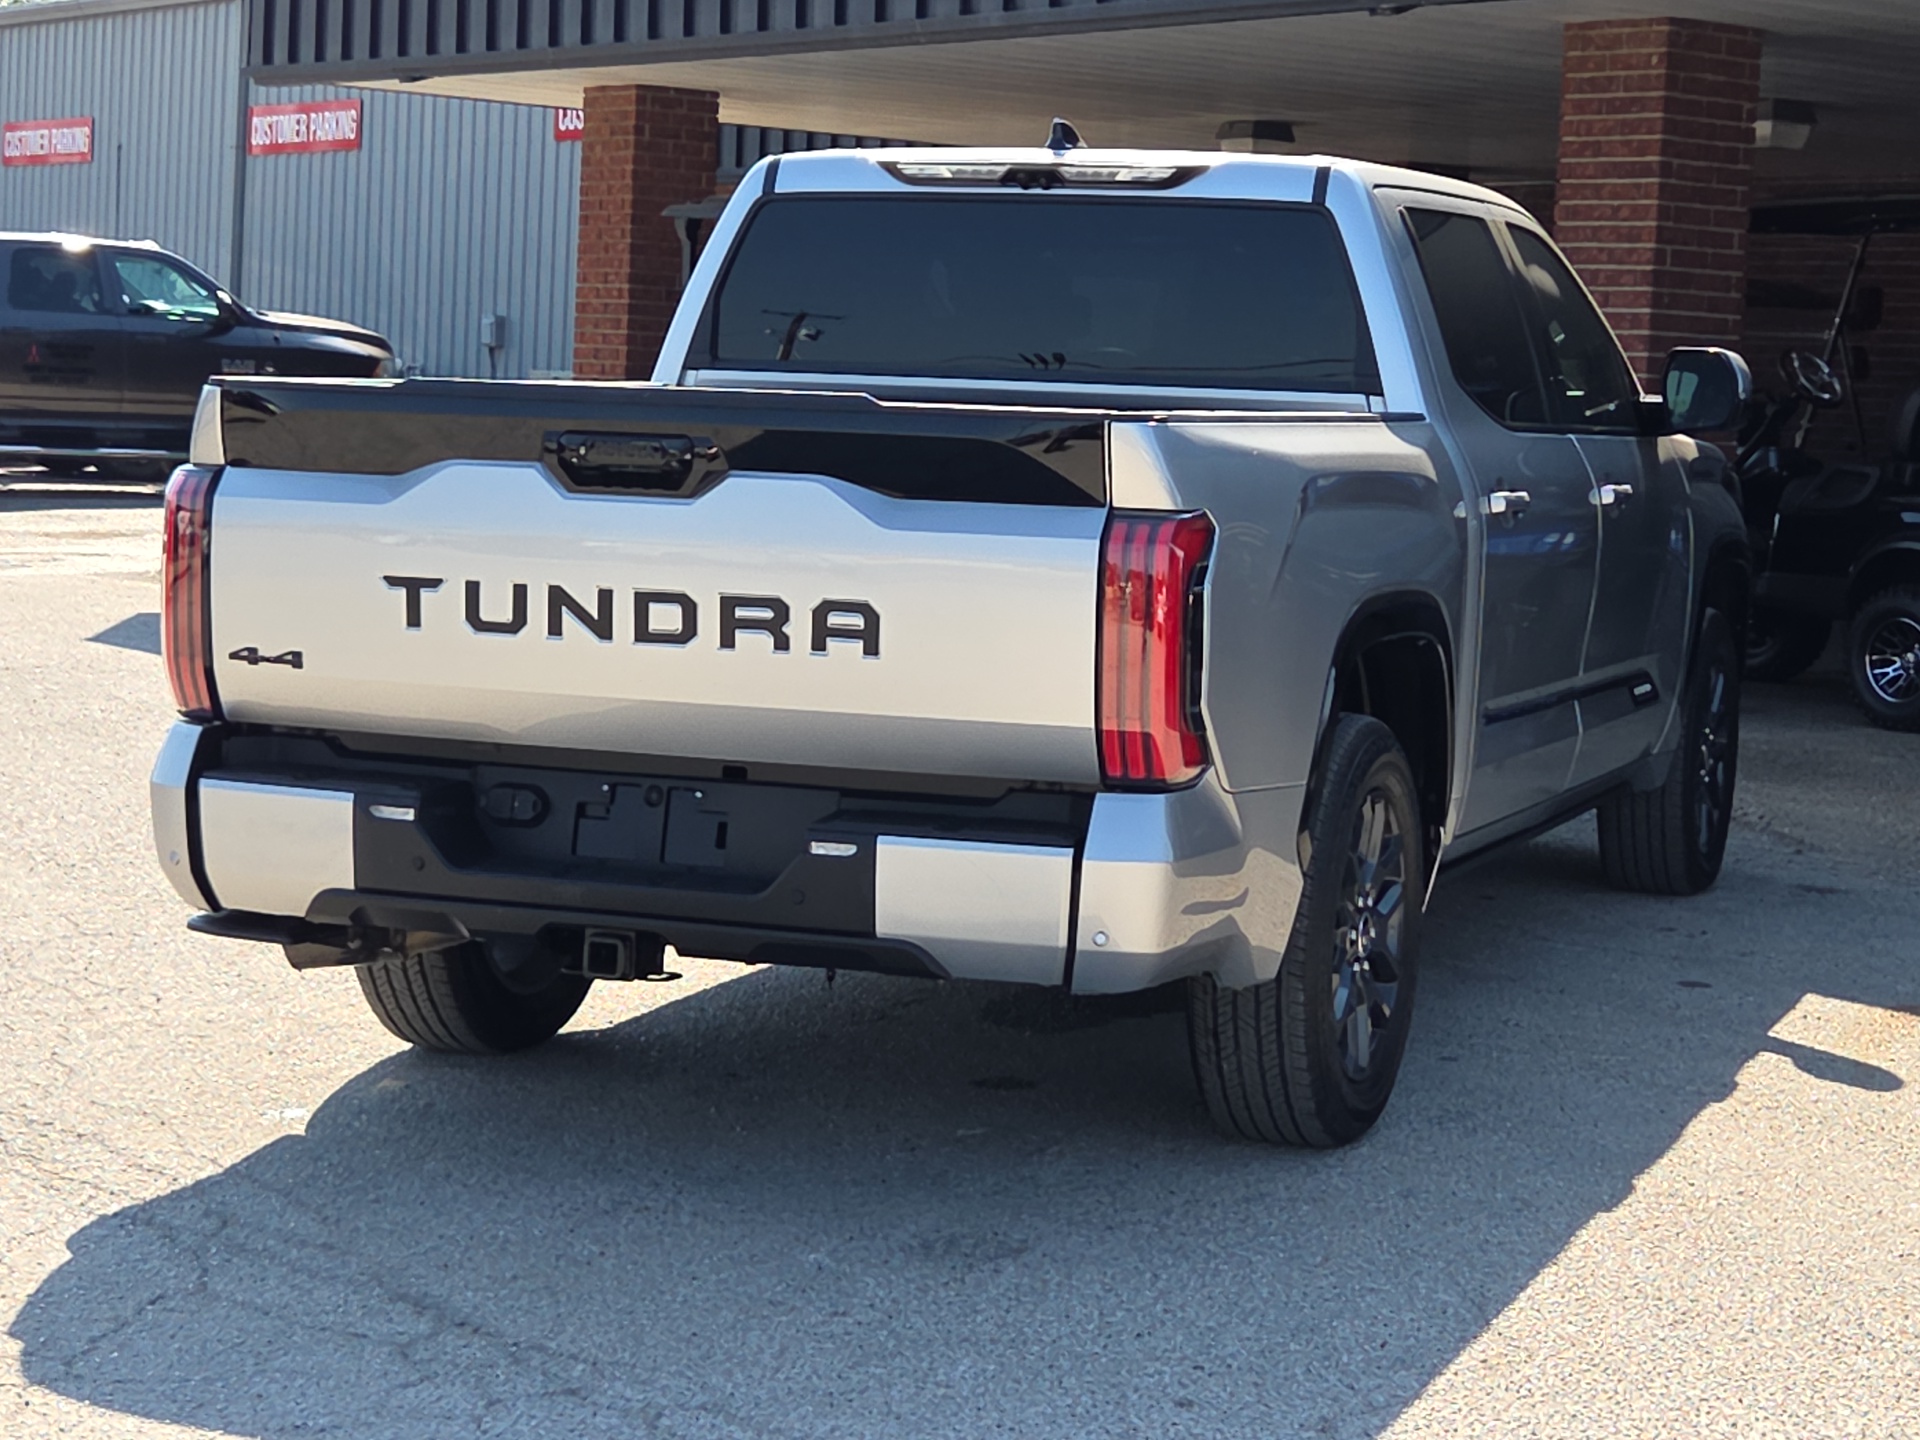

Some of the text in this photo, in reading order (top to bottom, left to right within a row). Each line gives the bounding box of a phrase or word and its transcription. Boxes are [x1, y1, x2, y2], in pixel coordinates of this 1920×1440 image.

[4, 127, 90, 157] CUSTOMER PARKING
[251, 109, 357, 145] CUSTOMER PARKING
[380, 575, 881, 659] TUNDRA
